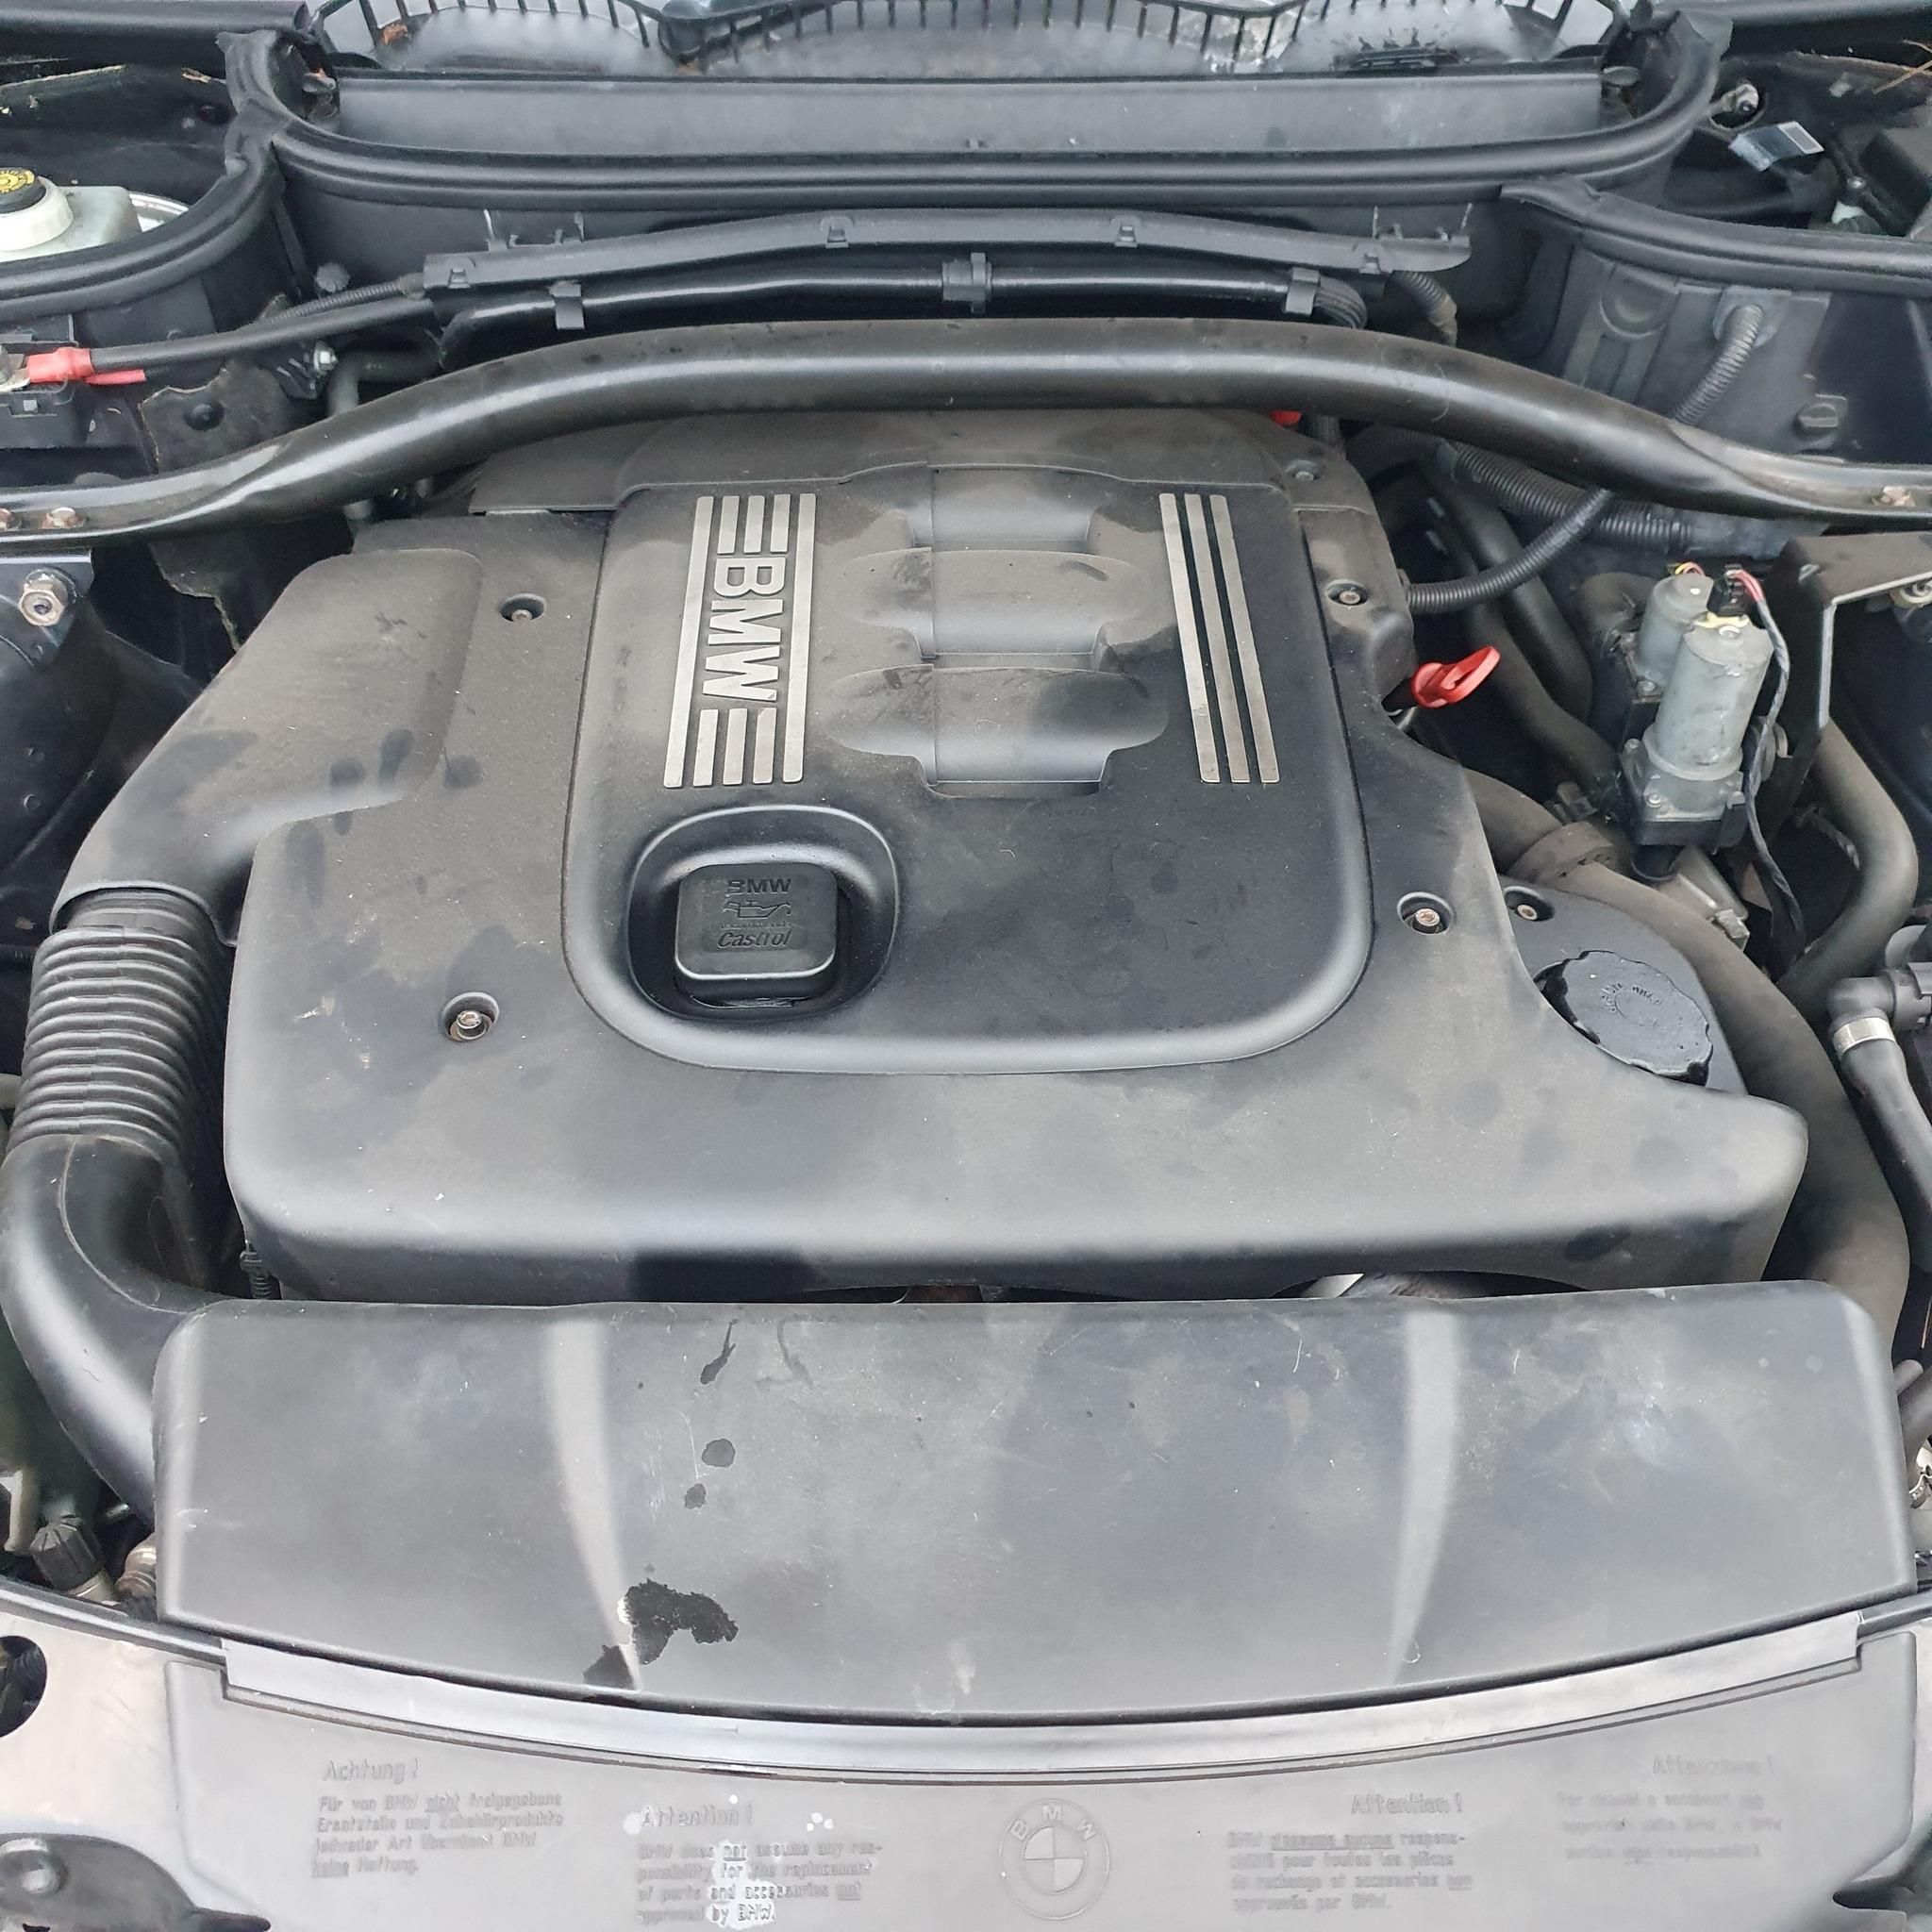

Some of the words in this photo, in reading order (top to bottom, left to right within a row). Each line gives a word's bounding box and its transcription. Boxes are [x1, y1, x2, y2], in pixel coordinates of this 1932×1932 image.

[702, 556, 785, 704] BMW
[727, 878, 791, 893] BMW
[717, 930, 791, 947] Castrol
[322, 1759, 405, 1785] Achtung
[318, 1796, 341, 1811] Für
[349, 1798, 376, 1810] von
[383, 1795, 418, 1811] BMW
[425, 1793, 458, 1812] nicht
[1350, 1793, 1450, 1814] Attention
[406, 1815, 430, 1830] und
[642, 1806, 739, 1826] Attention
[1005, 1804, 1097, 1841] BMW
[386, 1836, 411, 1851] Art
[502, 1831, 536, 1848] BMW
[722, 1844, 746, 1861] not
[816, 1842, 841, 1857] any
[720, 1862, 742, 1879] for
[710, 1884, 734, 1900] and
[711, 1905, 729, 1926] by
[737, 1903, 774, 1923] BMW.
